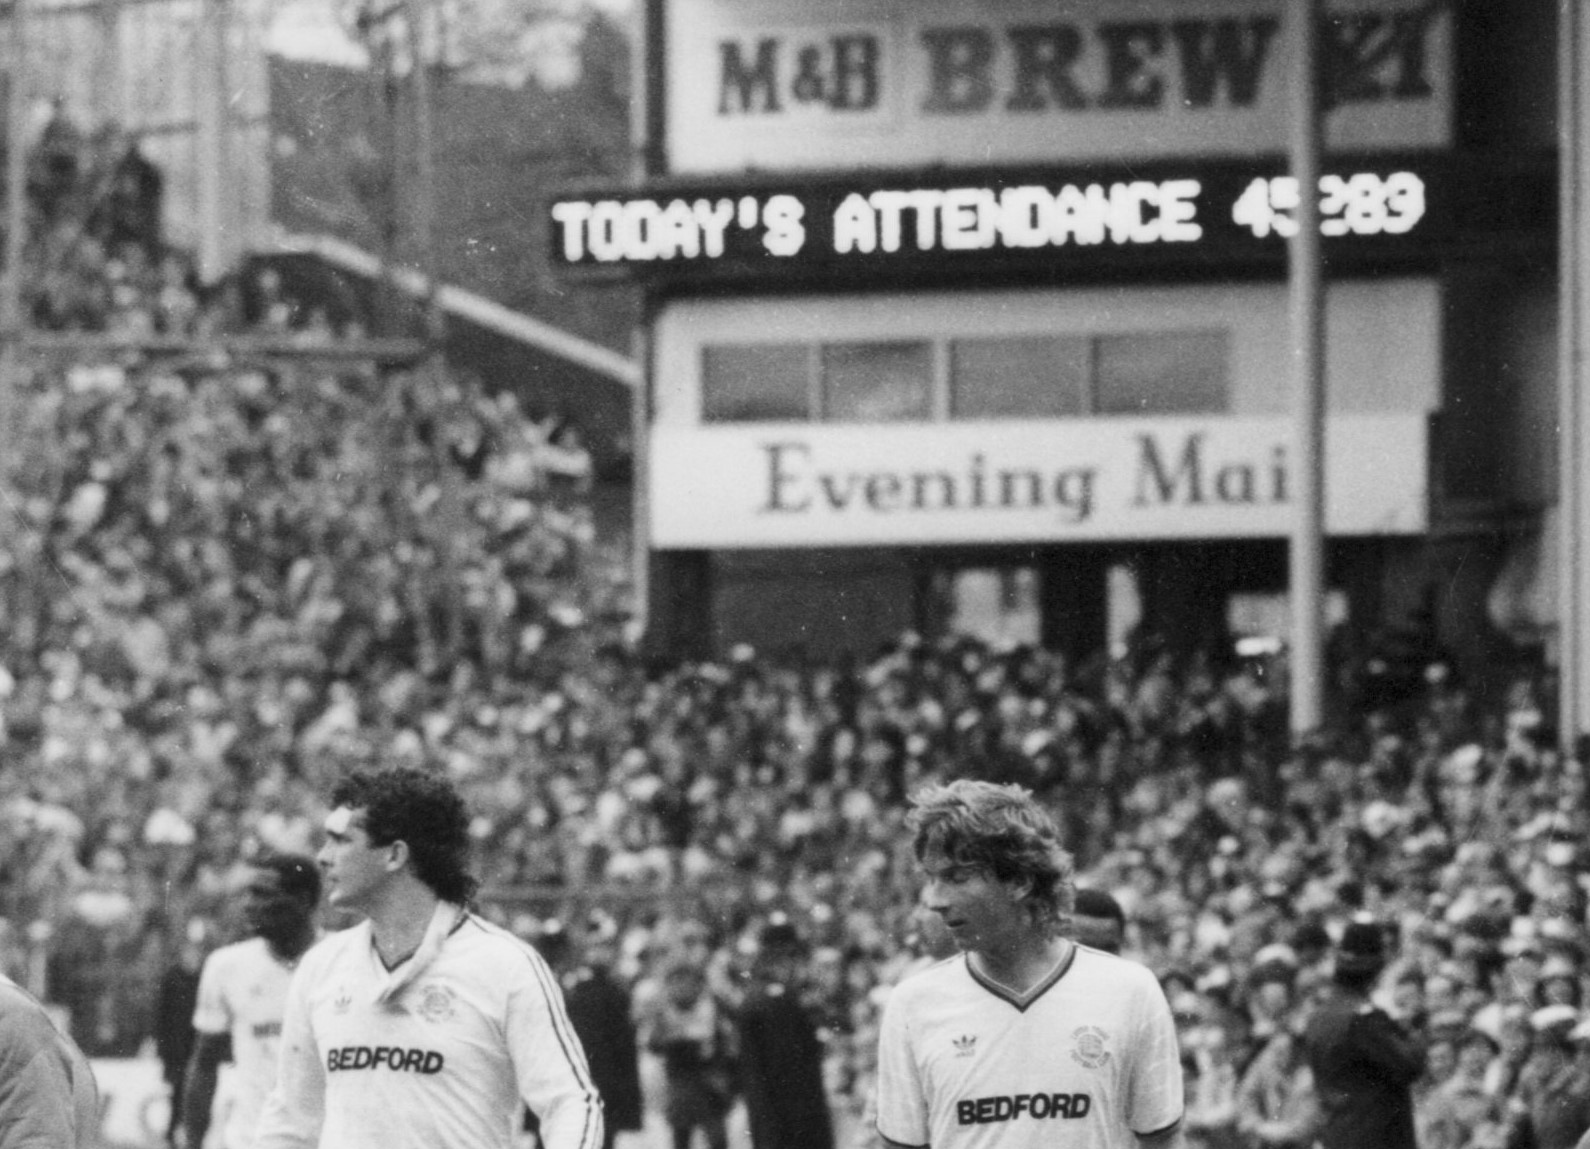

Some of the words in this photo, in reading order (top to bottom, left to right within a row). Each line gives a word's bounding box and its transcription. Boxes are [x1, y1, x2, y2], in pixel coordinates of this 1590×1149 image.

[717, 32, 882, 116] M&B
[918, 18, 1281, 115] BREW
[553, 195, 804, 261] TODAY'S
[833, 179, 1202, 253] ATTENDANCE
[758, 441, 1097, 524] Evening
[1130, 430, 1298, 508] Mai
[327, 1046, 444, 1075] BEDFORD
[956, 1092, 1092, 1126] BEDFORD
